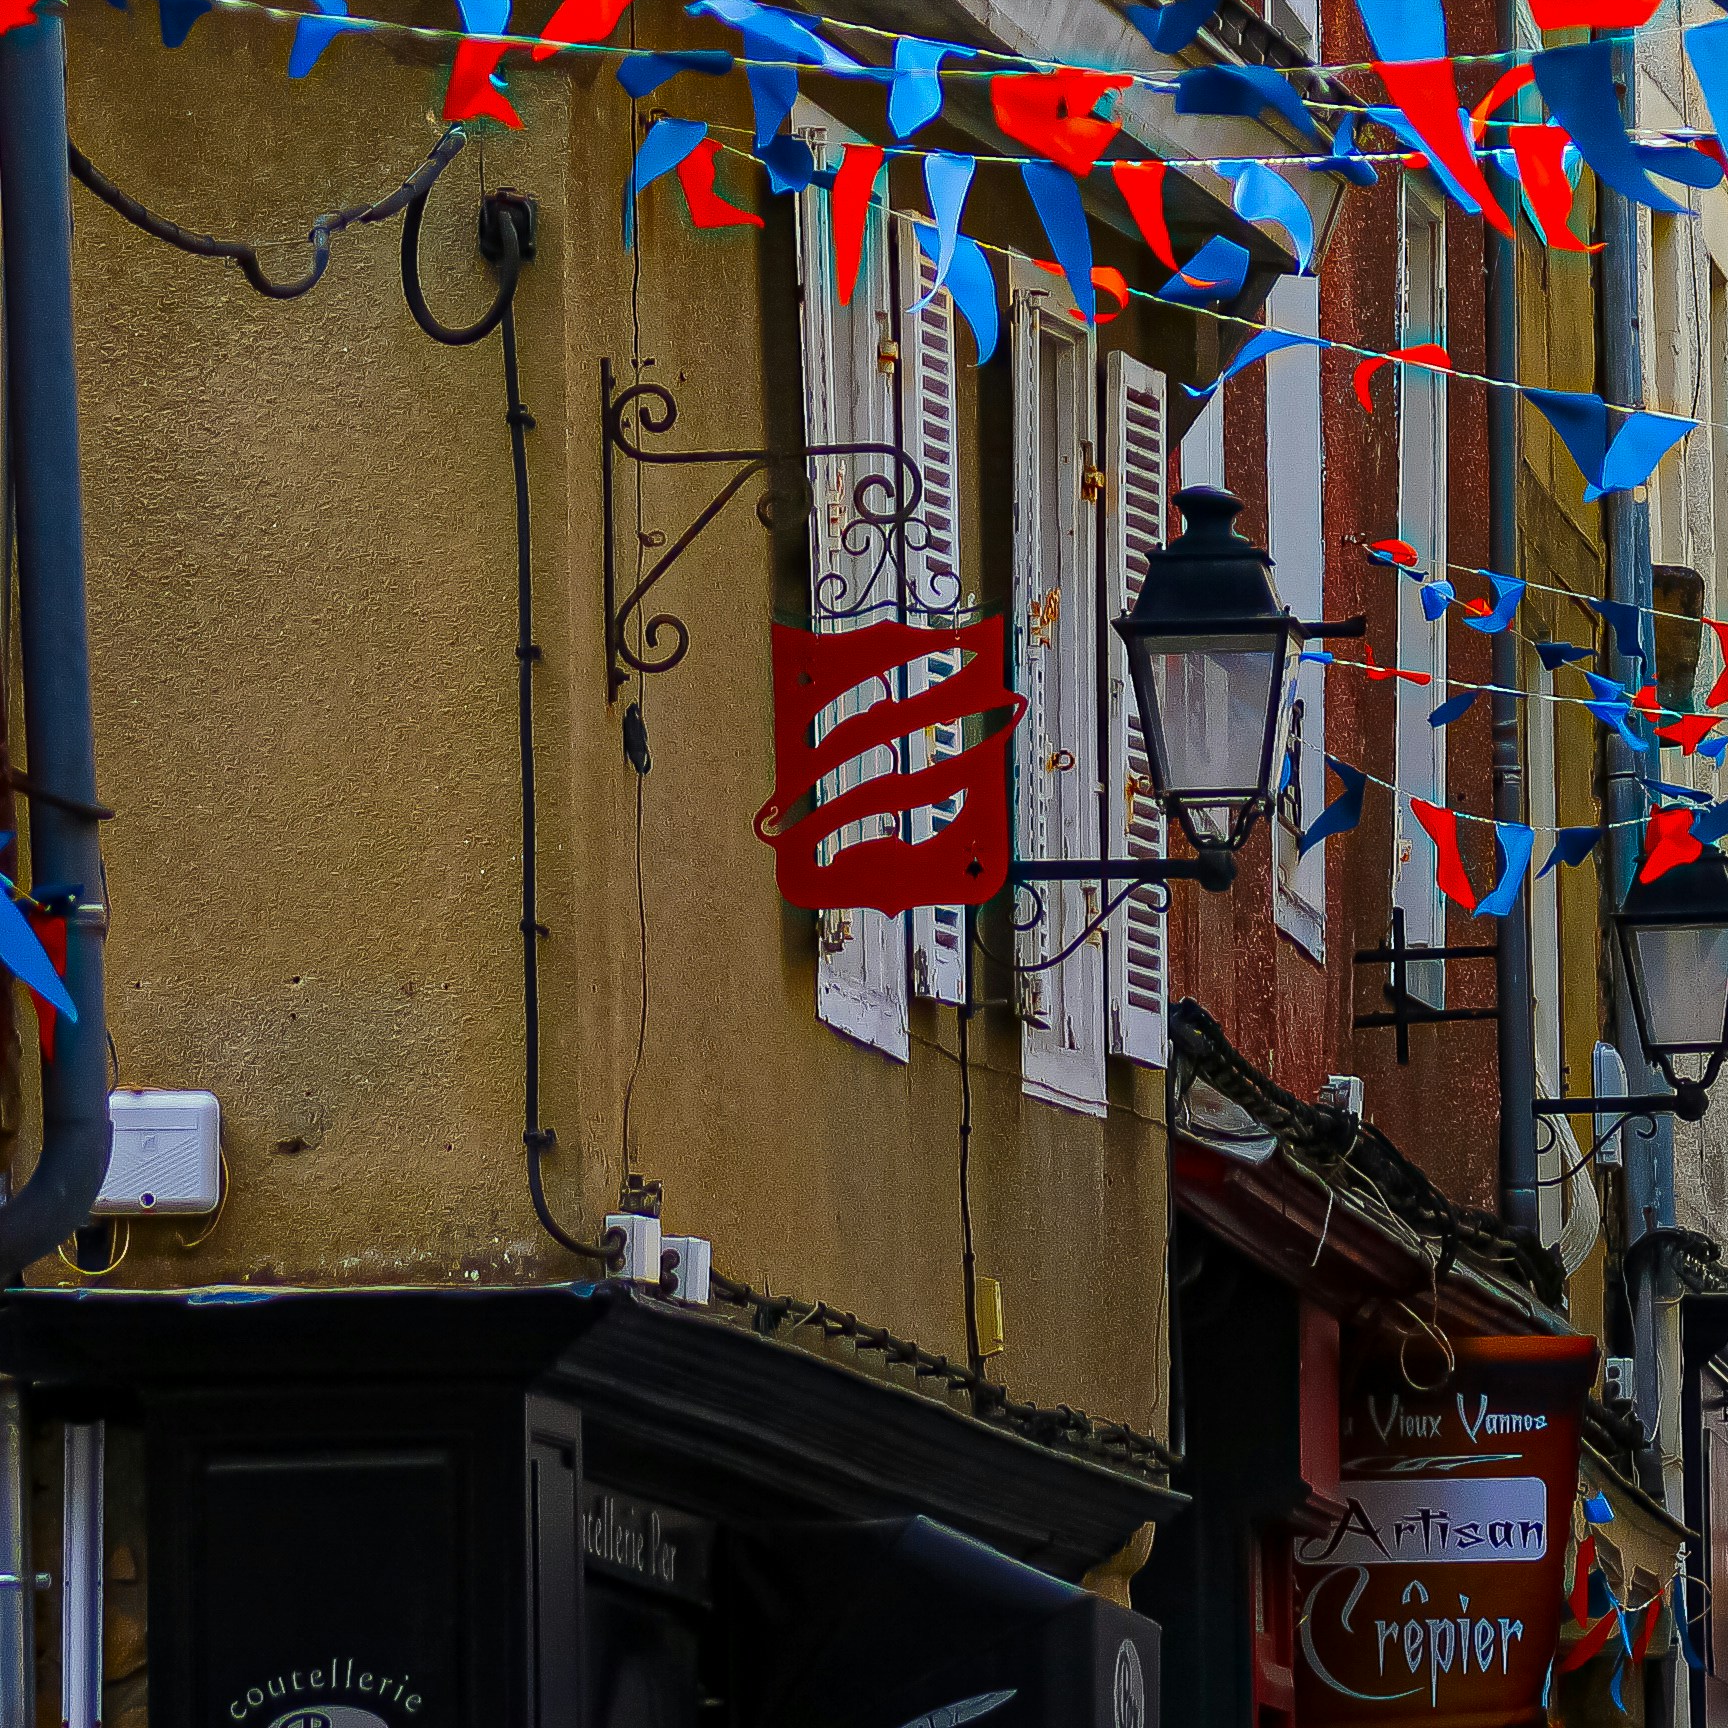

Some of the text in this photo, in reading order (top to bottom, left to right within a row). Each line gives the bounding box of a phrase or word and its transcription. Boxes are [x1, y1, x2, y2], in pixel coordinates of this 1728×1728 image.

[1300, 1497, 1545, 1560] Artisan
[1300, 1564, 1524, 1708] Crêpier
[229, 1658, 423, 1719] coutellerie
